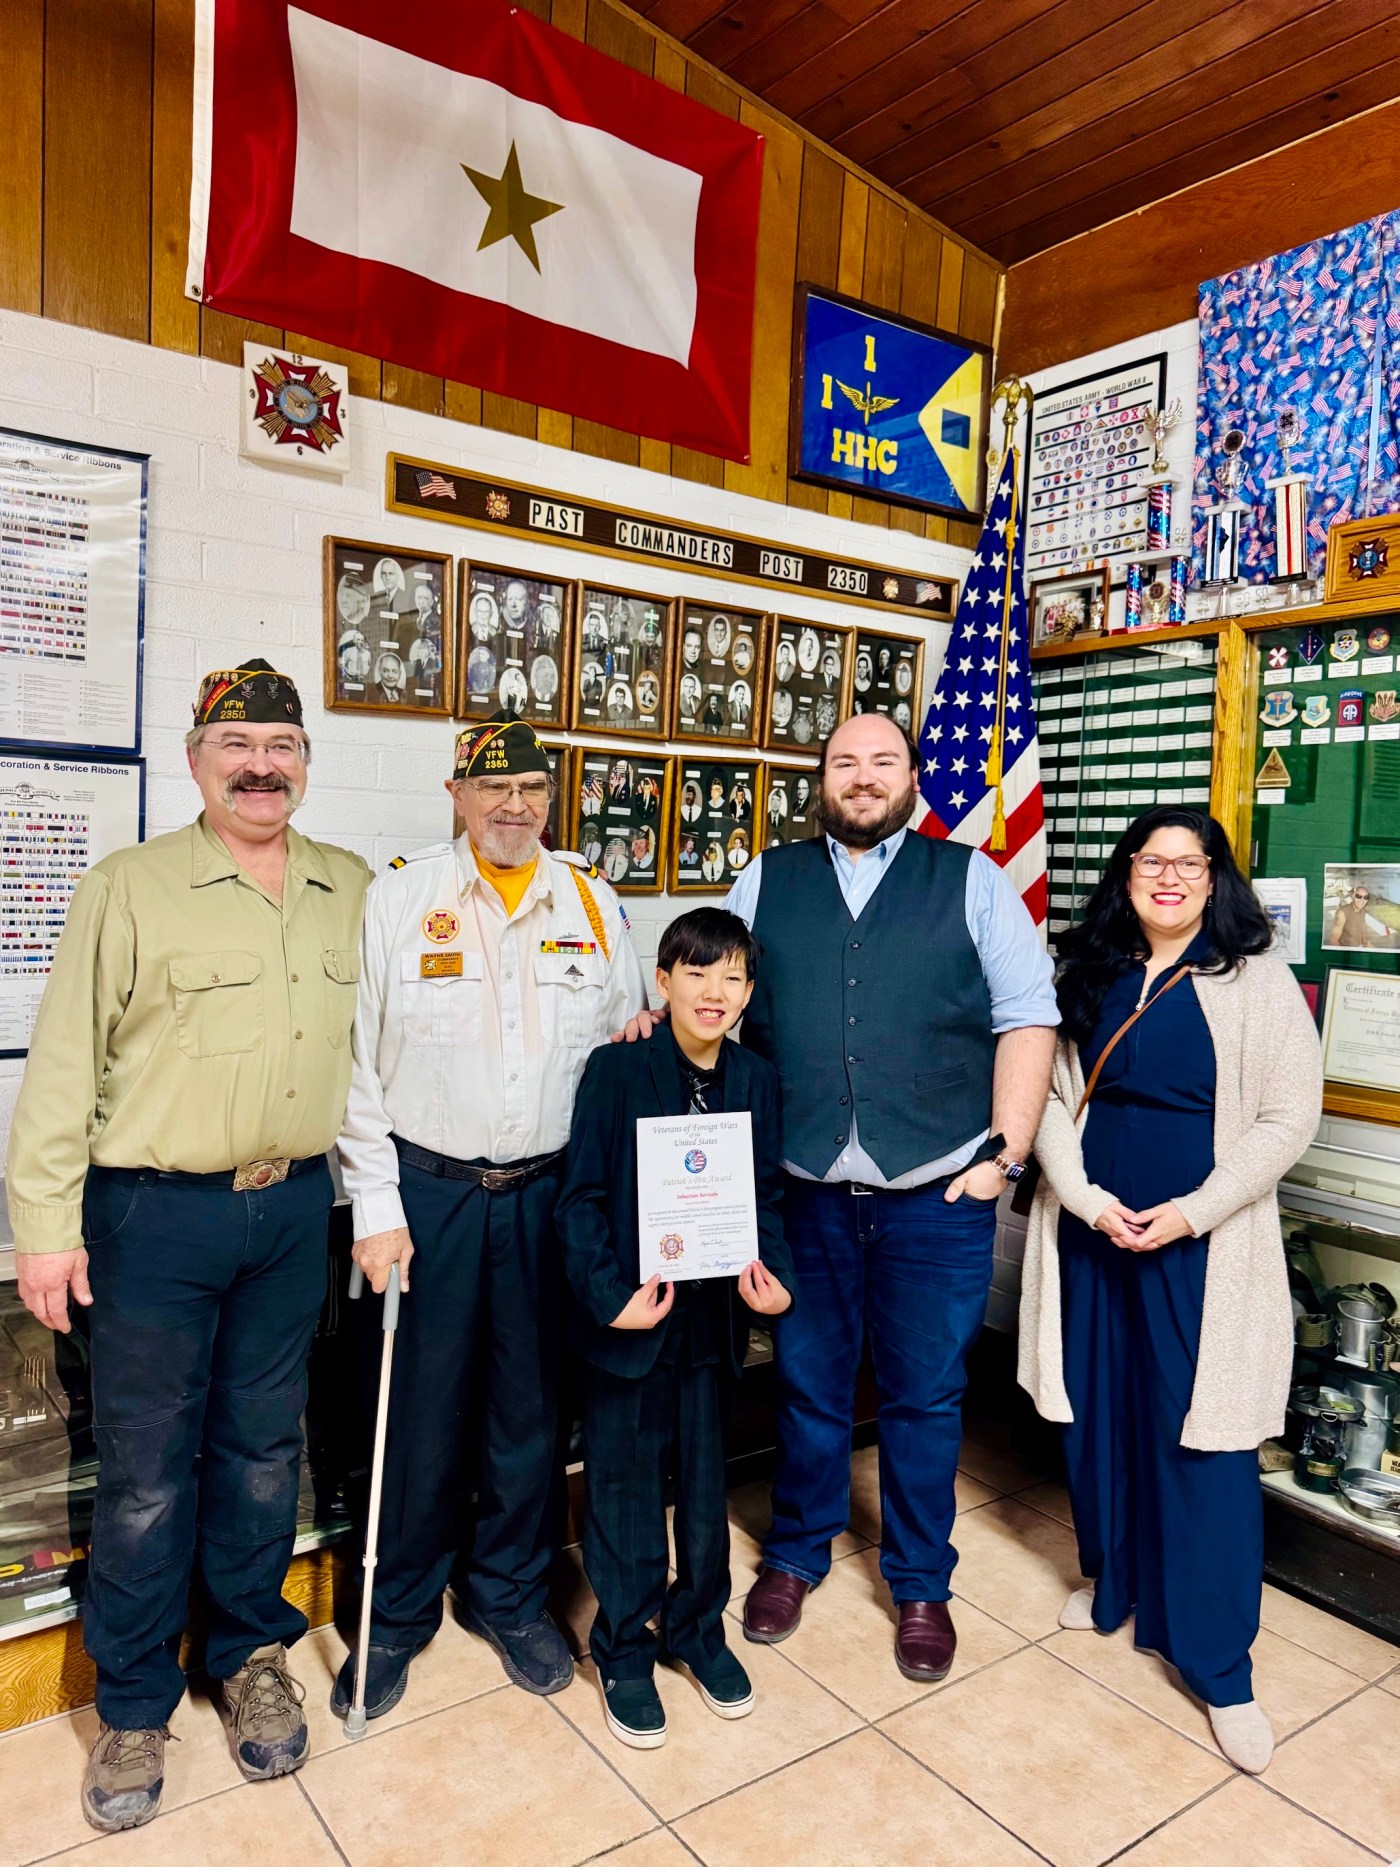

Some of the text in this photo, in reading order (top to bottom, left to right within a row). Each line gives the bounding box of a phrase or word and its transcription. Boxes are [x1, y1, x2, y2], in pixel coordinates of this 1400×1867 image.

[864, 335, 876, 372] 1
[292, 354, 303, 365] 12
[249, 388, 256, 399] 9
[821, 374, 833, 409] 1
[1042, 401, 1061, 414] UNITED
[1061, 397, 1083, 410] STATES
[1084, 390, 1100, 402] ARMY
[1106, 383, 1126, 395] WORLD
[1128, 378, 1141, 388] WAR
[340, 408, 346, 419] 3
[297, 445, 303, 456] 6
[831, 428, 898, 475] HHC
[34, 447, 41, 455] &
[45, 448, 80, 462] Service
[83, 454, 122, 470] Ribbons
[531, 504, 867, 591] PAST COMMANDERS POST 2350
[224, 700, 244, 709] VFW
[220, 710, 246, 719] 2350
[486, 750, 505, 759] VFW
[54, 763, 88, 773] Service
[91, 766, 129, 775] Ribbons
[485, 759, 508, 768] 2350
[1345, 983, 1395, 998] Certificate
[652, 1126, 682, 1134] Veterans
[683, 1123, 690, 1134] of
[692, 1123, 718, 1132] Foreign
[674, 1138, 718, 1146] United States
